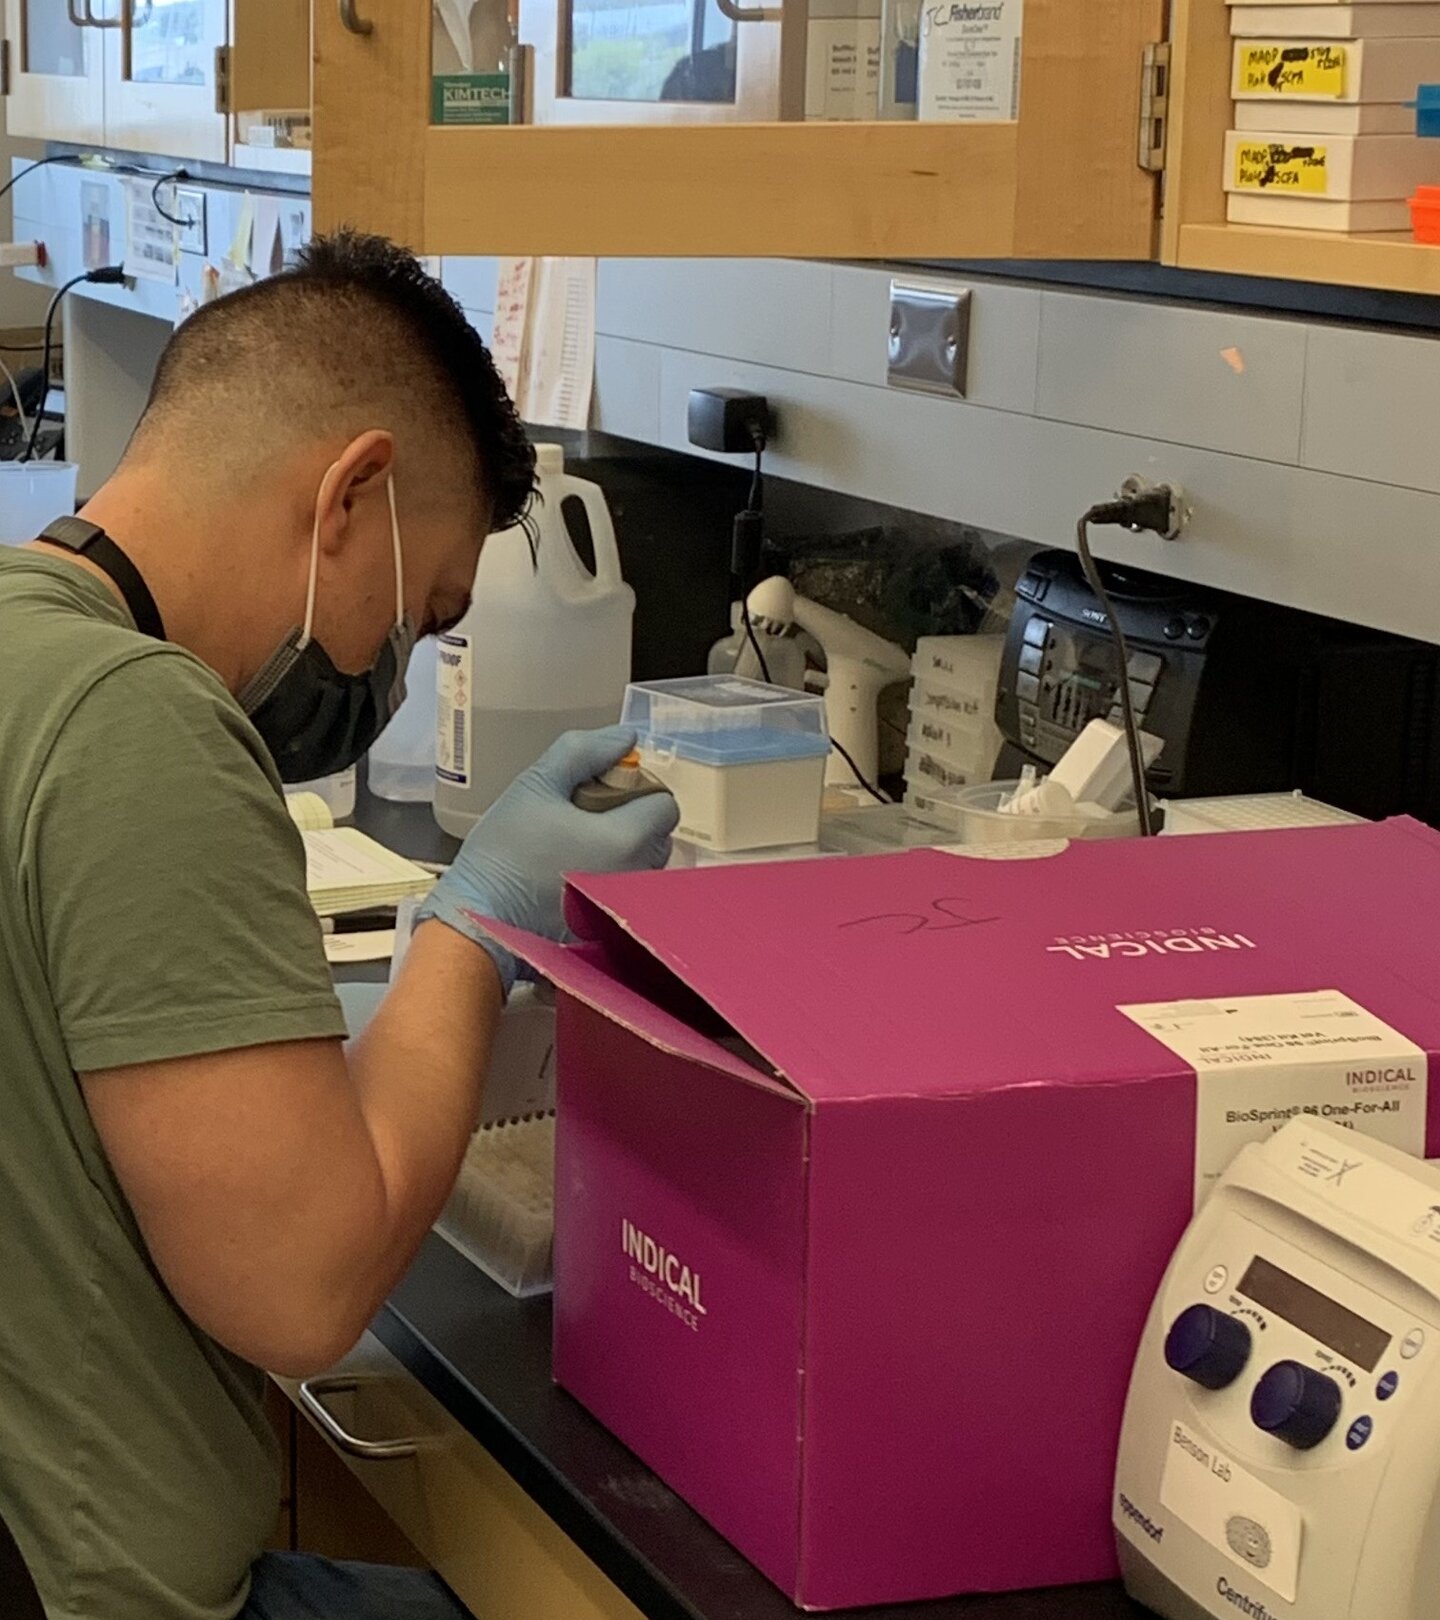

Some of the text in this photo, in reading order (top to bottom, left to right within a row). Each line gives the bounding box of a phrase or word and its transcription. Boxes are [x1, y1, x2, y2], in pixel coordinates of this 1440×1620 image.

[443, 87, 509, 101] KIMTECH
[1046, 933, 1257, 960] INDICAL
[1054, 926, 1216, 945] BIOSCIENCE
[1346, 1068, 1416, 1086] INDICAL
[1321, 1100, 1401, 1116] One-For-All
[622, 1218, 707, 1315] INDICAL
[629, 1265, 699, 1332] BIOSCIENCE
[1173, 1425, 1232, 1483] Benson Lab
[1118, 1493, 1164, 1545] eppendorf
[1216, 1576, 1278, 1620] Centrifu
